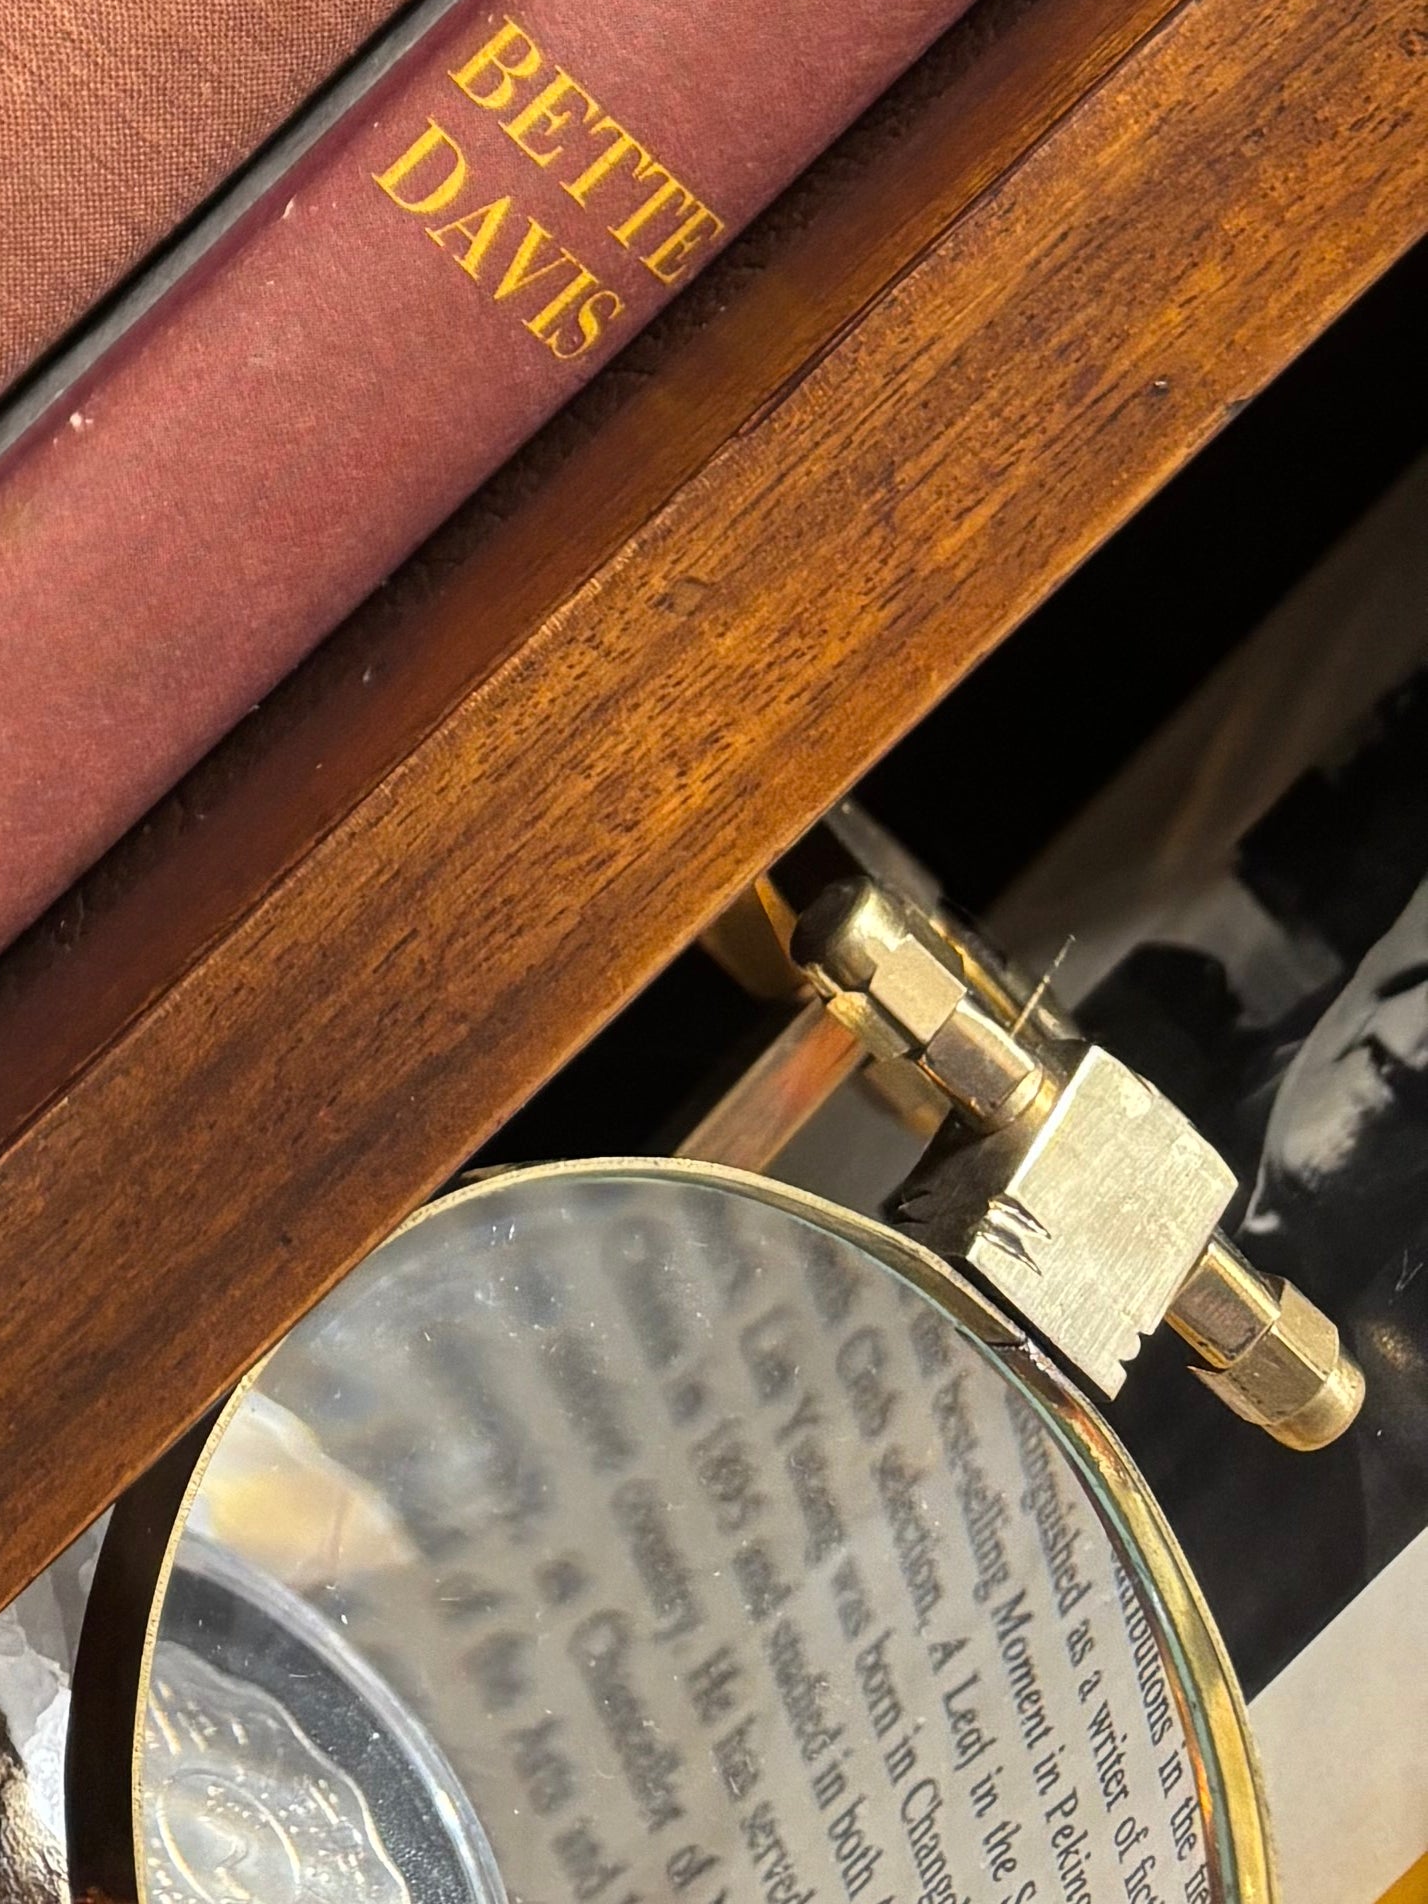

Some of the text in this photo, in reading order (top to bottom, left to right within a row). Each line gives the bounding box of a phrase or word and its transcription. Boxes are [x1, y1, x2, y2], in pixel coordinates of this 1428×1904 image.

[447, 14, 726, 286] BETTE
[370, 116, 625, 360] DAVIS
[927, 1633, 973, 1678] A
[1067, 1616, 1095, 1668] as
[853, 1628, 904, 1739] born
[883, 1722, 924, 1785] in
[941, 1671, 997, 1771] Leaf
[992, 1585, 1053, 1750] Moment
[1032, 1744, 1064, 1796] in
[1077, 1670, 1102, 1704] a
[811, 1744, 855, 1811] in
[1087, 1700, 1131, 1813] writer
[1158, 1738, 1187, 1799] in
[969, 1764, 1005, 1820] in
[827, 1792, 884, 1900] both
[982, 1817, 1023, 1882] the
[1113, 1813, 1151, 1866] of
[1169, 1792, 1202, 1861] the
